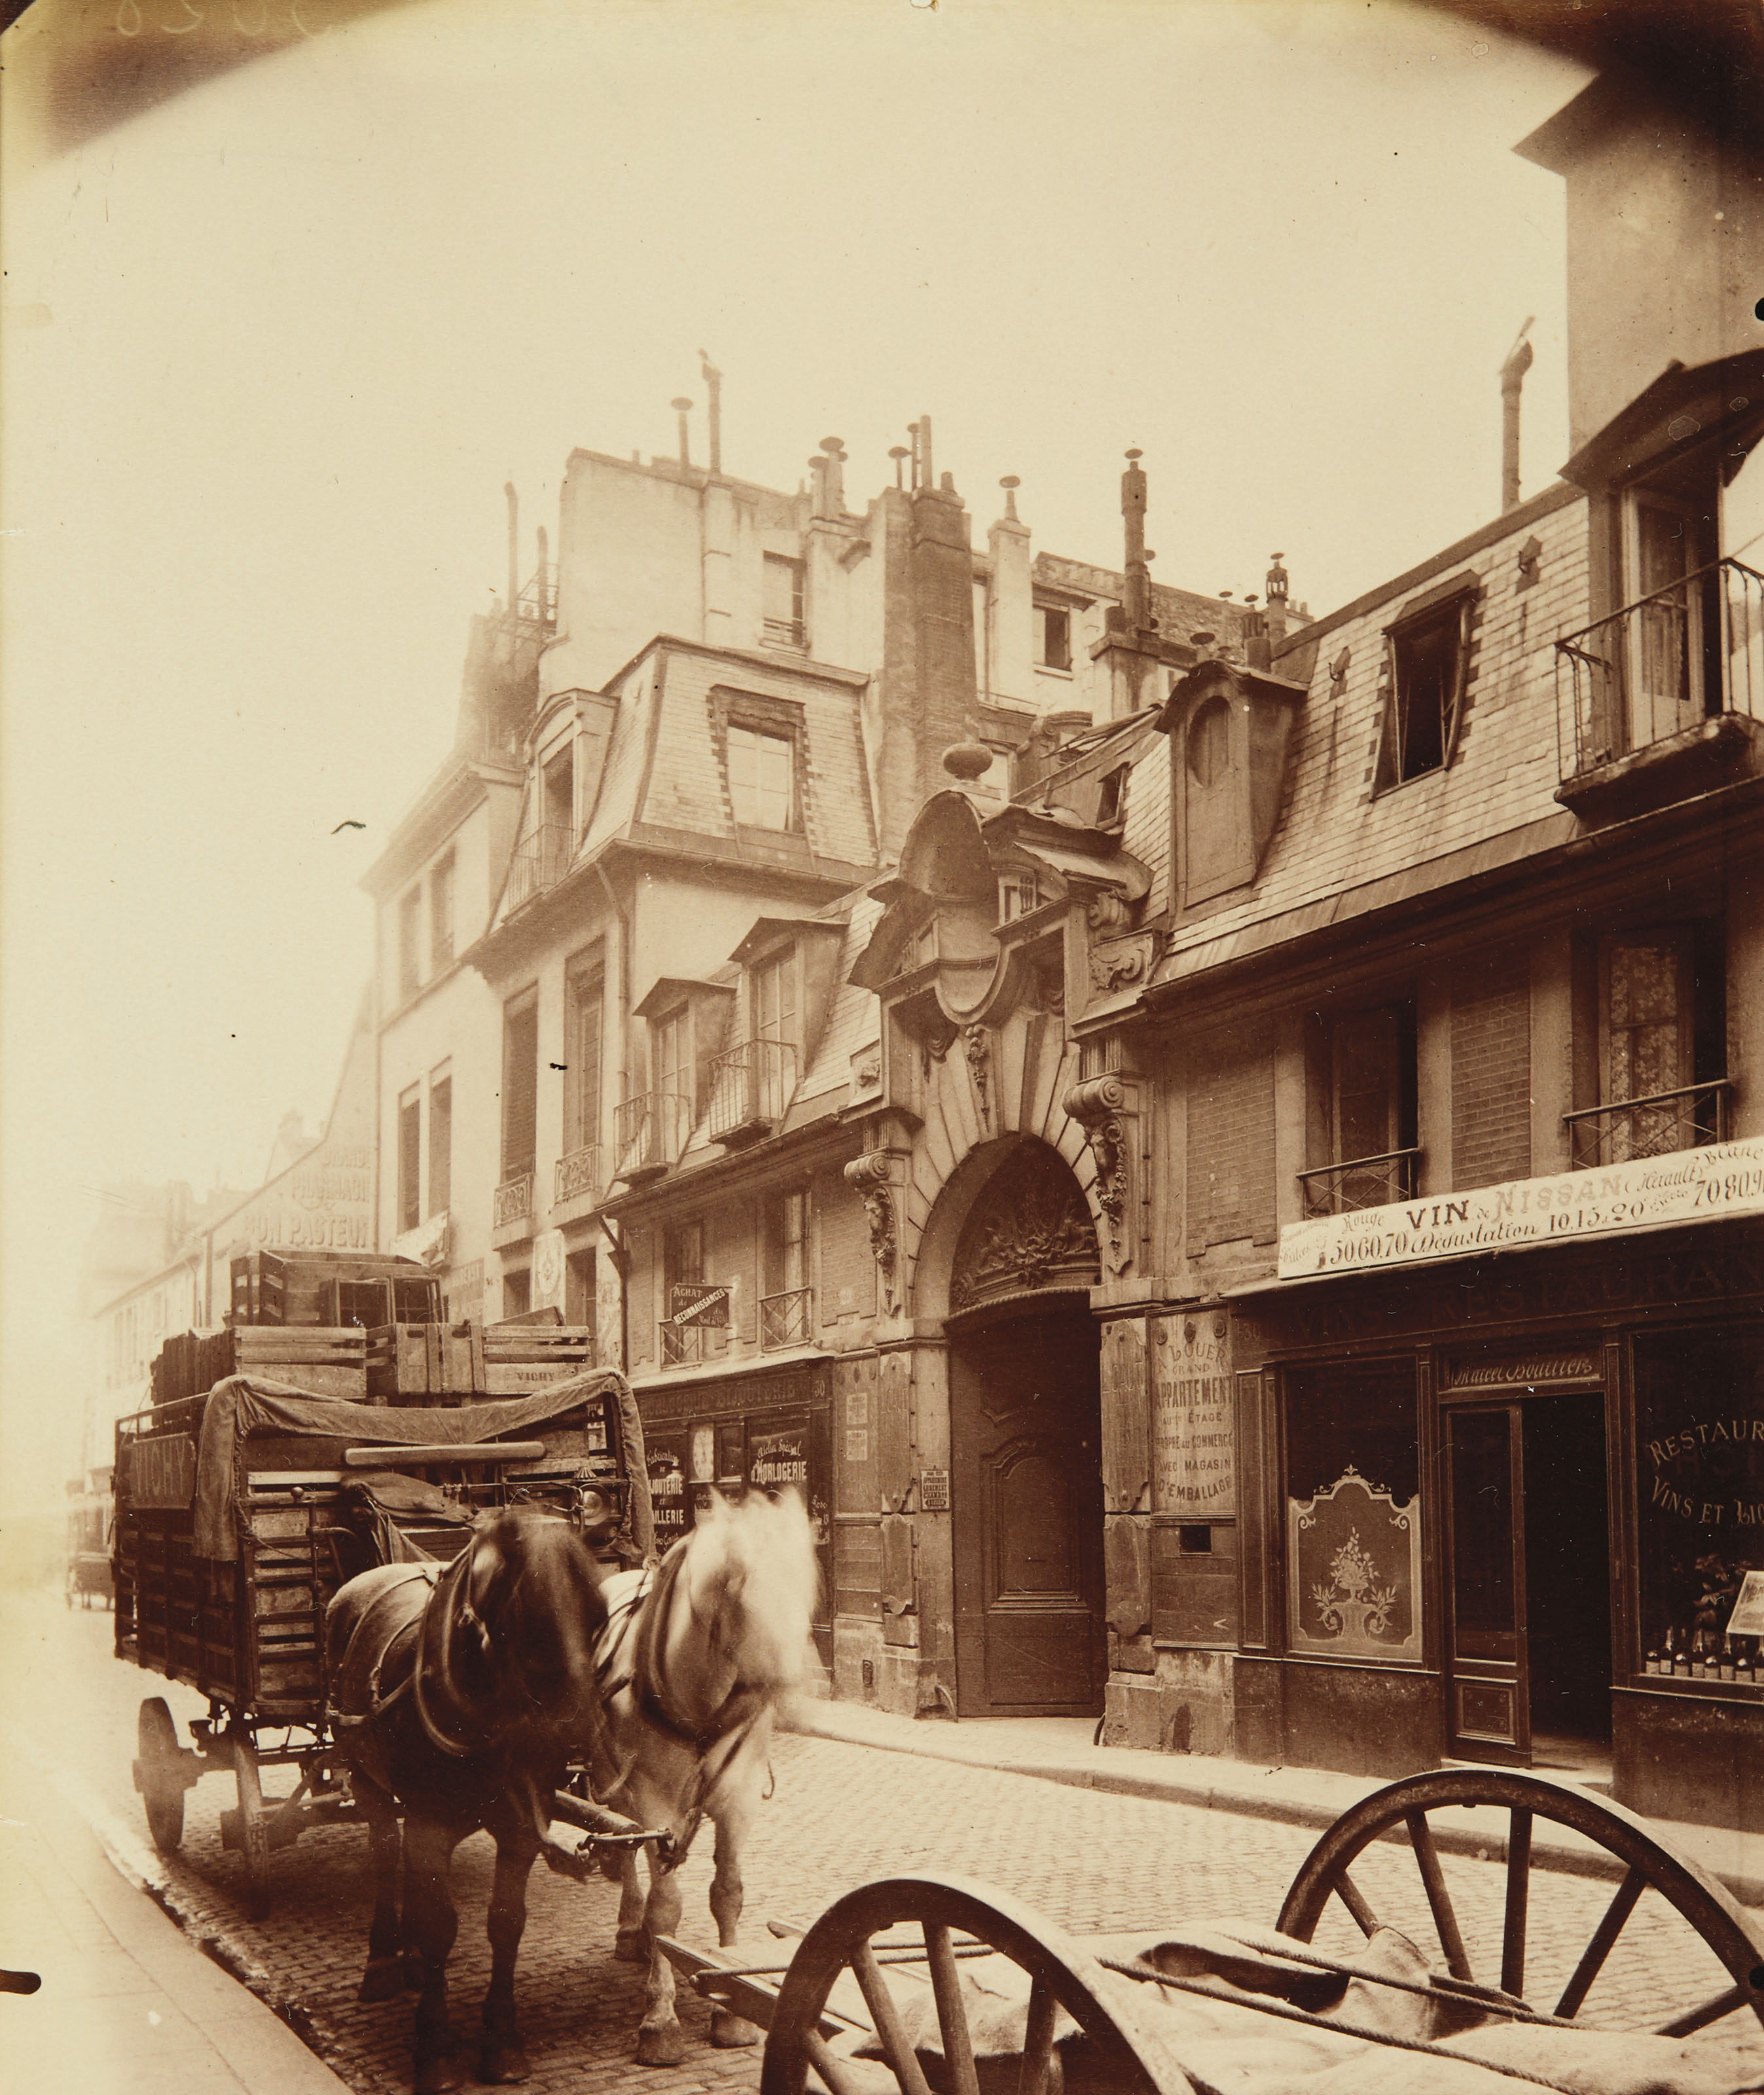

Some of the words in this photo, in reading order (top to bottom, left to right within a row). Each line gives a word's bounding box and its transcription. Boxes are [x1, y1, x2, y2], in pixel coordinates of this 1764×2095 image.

[1406, 1199, 1469, 1230] VIN
[1490, 1175, 1623, 1226] NISSAN
[673, 1288, 703, 1298] ACHAT
[673, 1288, 726, 1325] RECONNAISSANCES
[1168, 1342, 1226, 1368] LOUER
[516, 1372, 555, 1381] VICHY
[1172, 1362, 1210, 1375] GRAND
[1155, 1375, 1233, 1410] APPARTEMENT
[1188, 1410, 1222, 1424] ÉTAGE
[1646, 1419, 1764, 1470] RESTAUR
[1159, 1461, 1178, 1472] AVEC
[1184, 1458, 1231, 1472] MAGASIN
[648, 1478, 683, 1495] IJOUTERIE
[1157, 1476, 1232, 1501] D'EMBALLAGE
[1652, 1476, 1694, 1518] VINS
[1702, 1503, 1724, 1524] ET
[655, 1509, 685, 1525] ILLERIE
